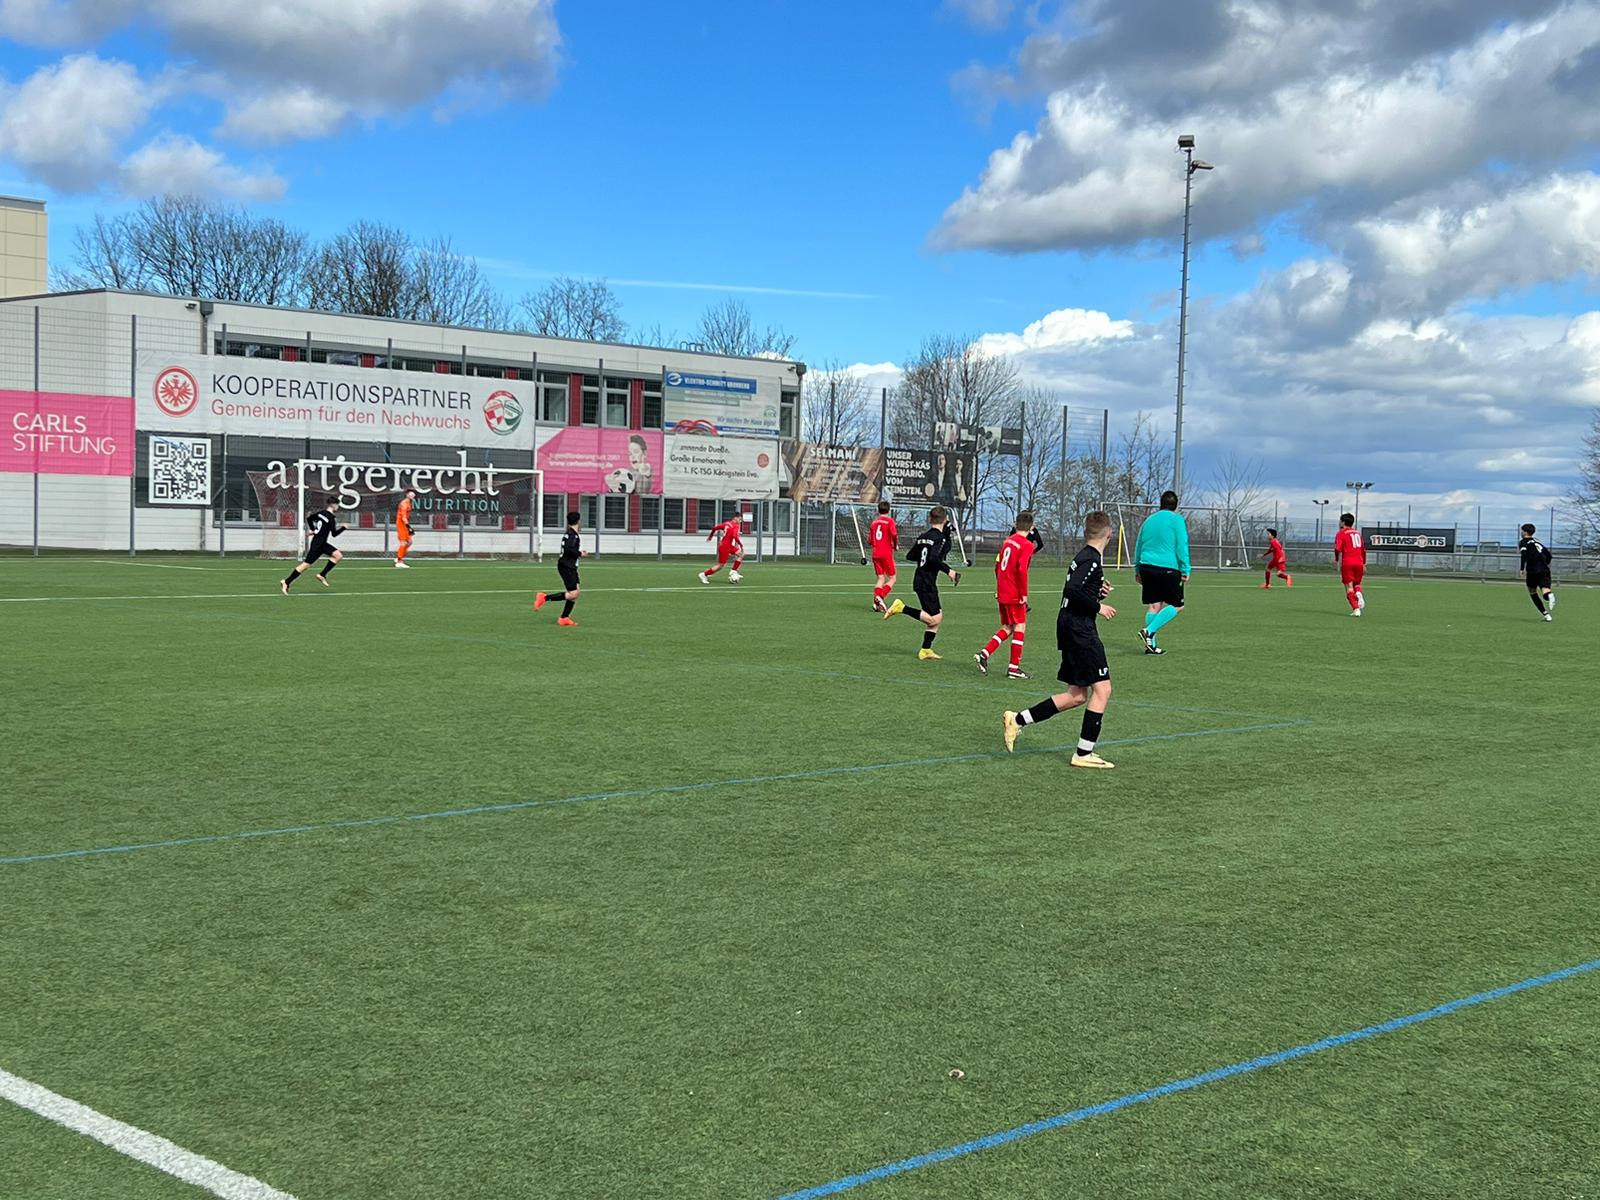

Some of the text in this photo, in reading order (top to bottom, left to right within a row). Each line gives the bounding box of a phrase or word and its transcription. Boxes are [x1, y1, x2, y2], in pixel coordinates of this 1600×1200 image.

[212, 374, 472, 410] KOOPERATIONSPARTNER
[211, 400, 472, 430] Gemeinsam für den Nachwuchs
[12, 412, 87, 434] CARLS
[12, 432, 117, 456] STIFTUNG
[670, 454, 728, 465] Große Emotionen.
[810, 447, 858, 460] SELMANI
[886, 451, 912, 459] UNSER
[886, 459, 931, 470] WURST-KÄS
[265, 450, 500, 509] artgerecht
[713, 468, 746, 479] Königstein
[886, 468, 925, 478] SZENARIO.
[885, 477, 904, 485] VOM
[412, 498, 500, 512] NUTRITION
[875, 524, 883, 541] 6
[1350, 533, 1362, 548] 10
[1001, 546, 1011, 571] 8
